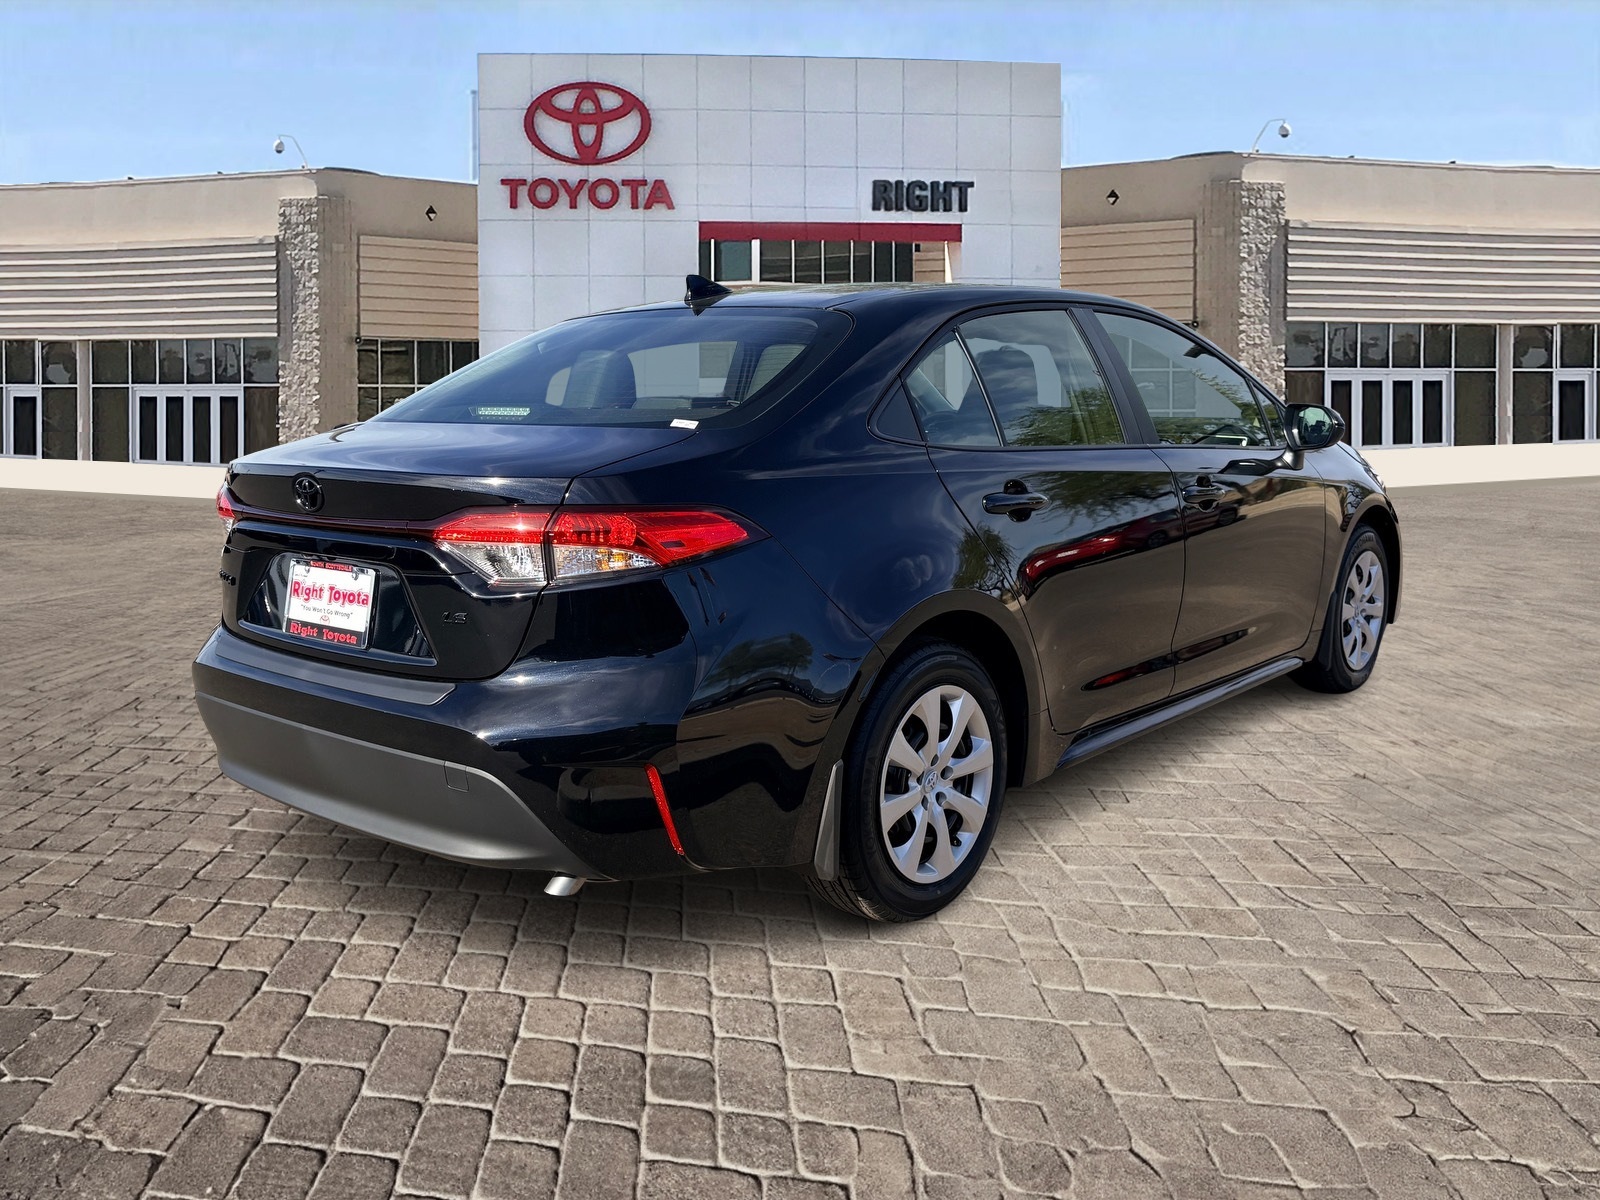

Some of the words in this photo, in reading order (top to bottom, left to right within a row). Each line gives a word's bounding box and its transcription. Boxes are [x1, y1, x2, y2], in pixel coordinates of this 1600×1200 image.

[500, 178, 675, 211] TOYOTA
[871, 178, 976, 214] RIGHT
[292, 580, 325, 603] Right
[328, 584, 370, 607] Toyota
[326, 608, 334, 616] Go
[290, 622, 318, 637] Right
[323, 629, 357, 644] Toyota
